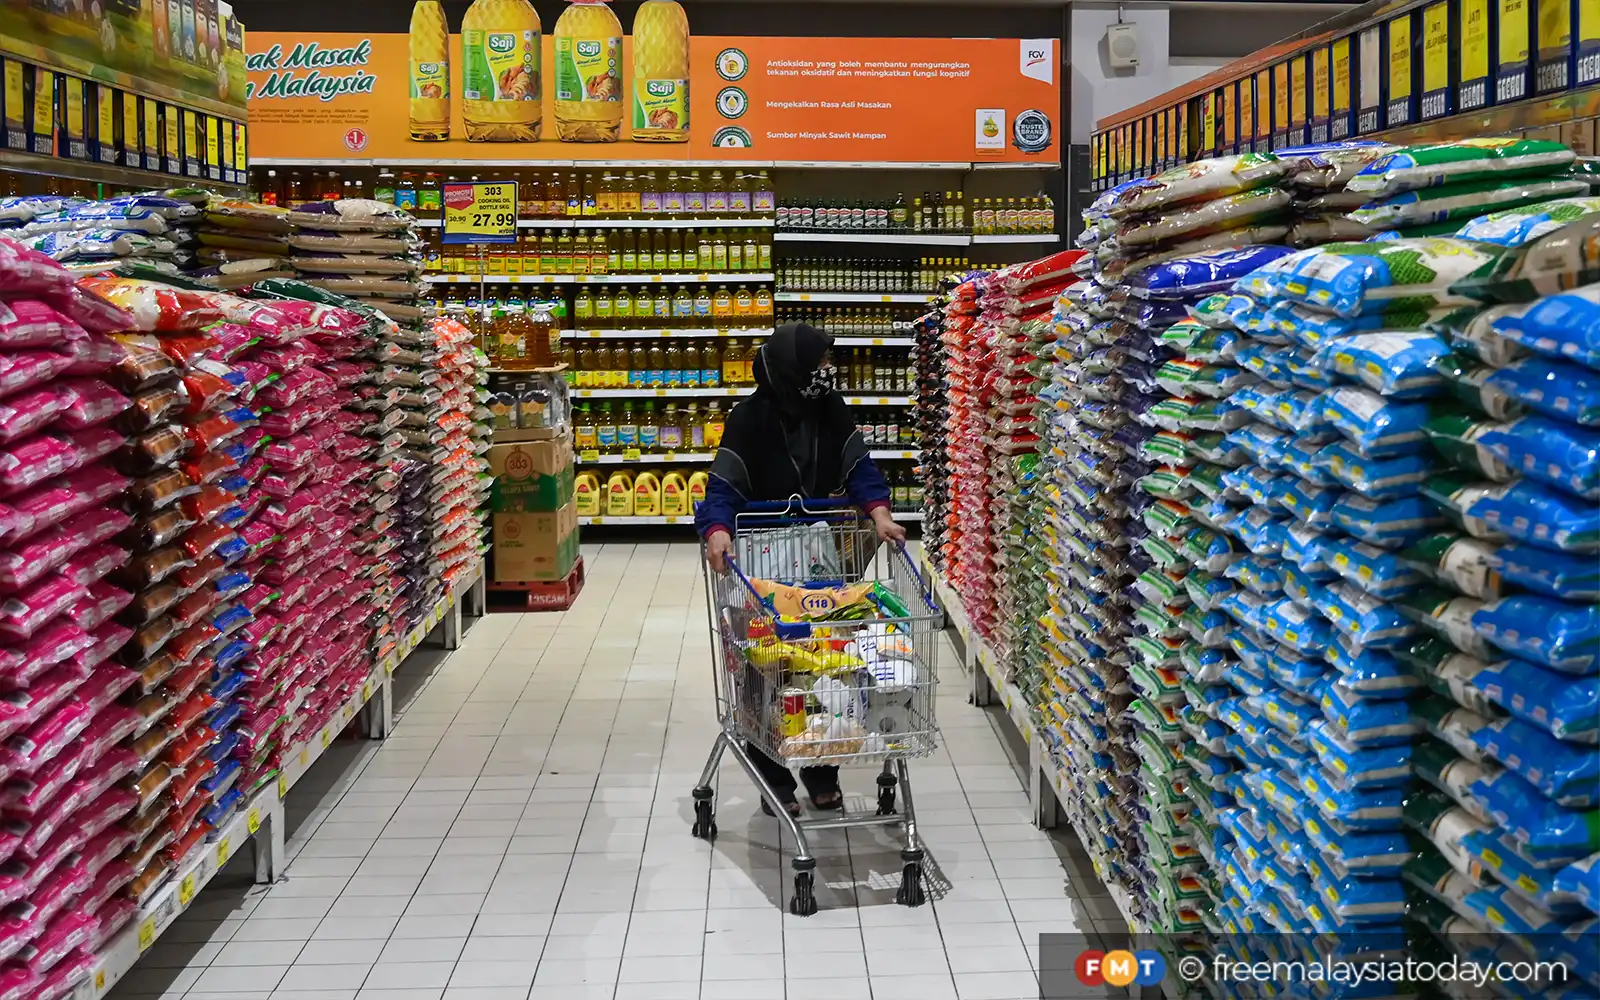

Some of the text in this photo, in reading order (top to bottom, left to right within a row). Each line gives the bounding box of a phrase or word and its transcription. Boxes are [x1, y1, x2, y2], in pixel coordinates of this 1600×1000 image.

[490, 36, 513, 51] Saji
[578, 43, 599, 53] Saji
[246, 39, 371, 71] ak Masak
[1028, 50, 1045, 58] FGV
[421, 65, 437, 73] Saji
[766, 59, 970, 70] Antioksidan yang boleh membantu mengurangkan
[766, 68, 970, 79] tekanan oksidatif dan meningkatkan fungsi kognitif
[257, 70, 377, 102] Malaysia
[649, 82, 672, 95] Saji
[766, 100, 892, 110] Mengekalkan Rasa Asli Masakan
[766, 130, 887, 140] Sumber Minyak Sawit Mampan
[484, 186, 502, 196] 303
[472, 213, 515, 227] 27.99
[509, 459, 528, 470] 303
[808, 599, 828, 608] 118
